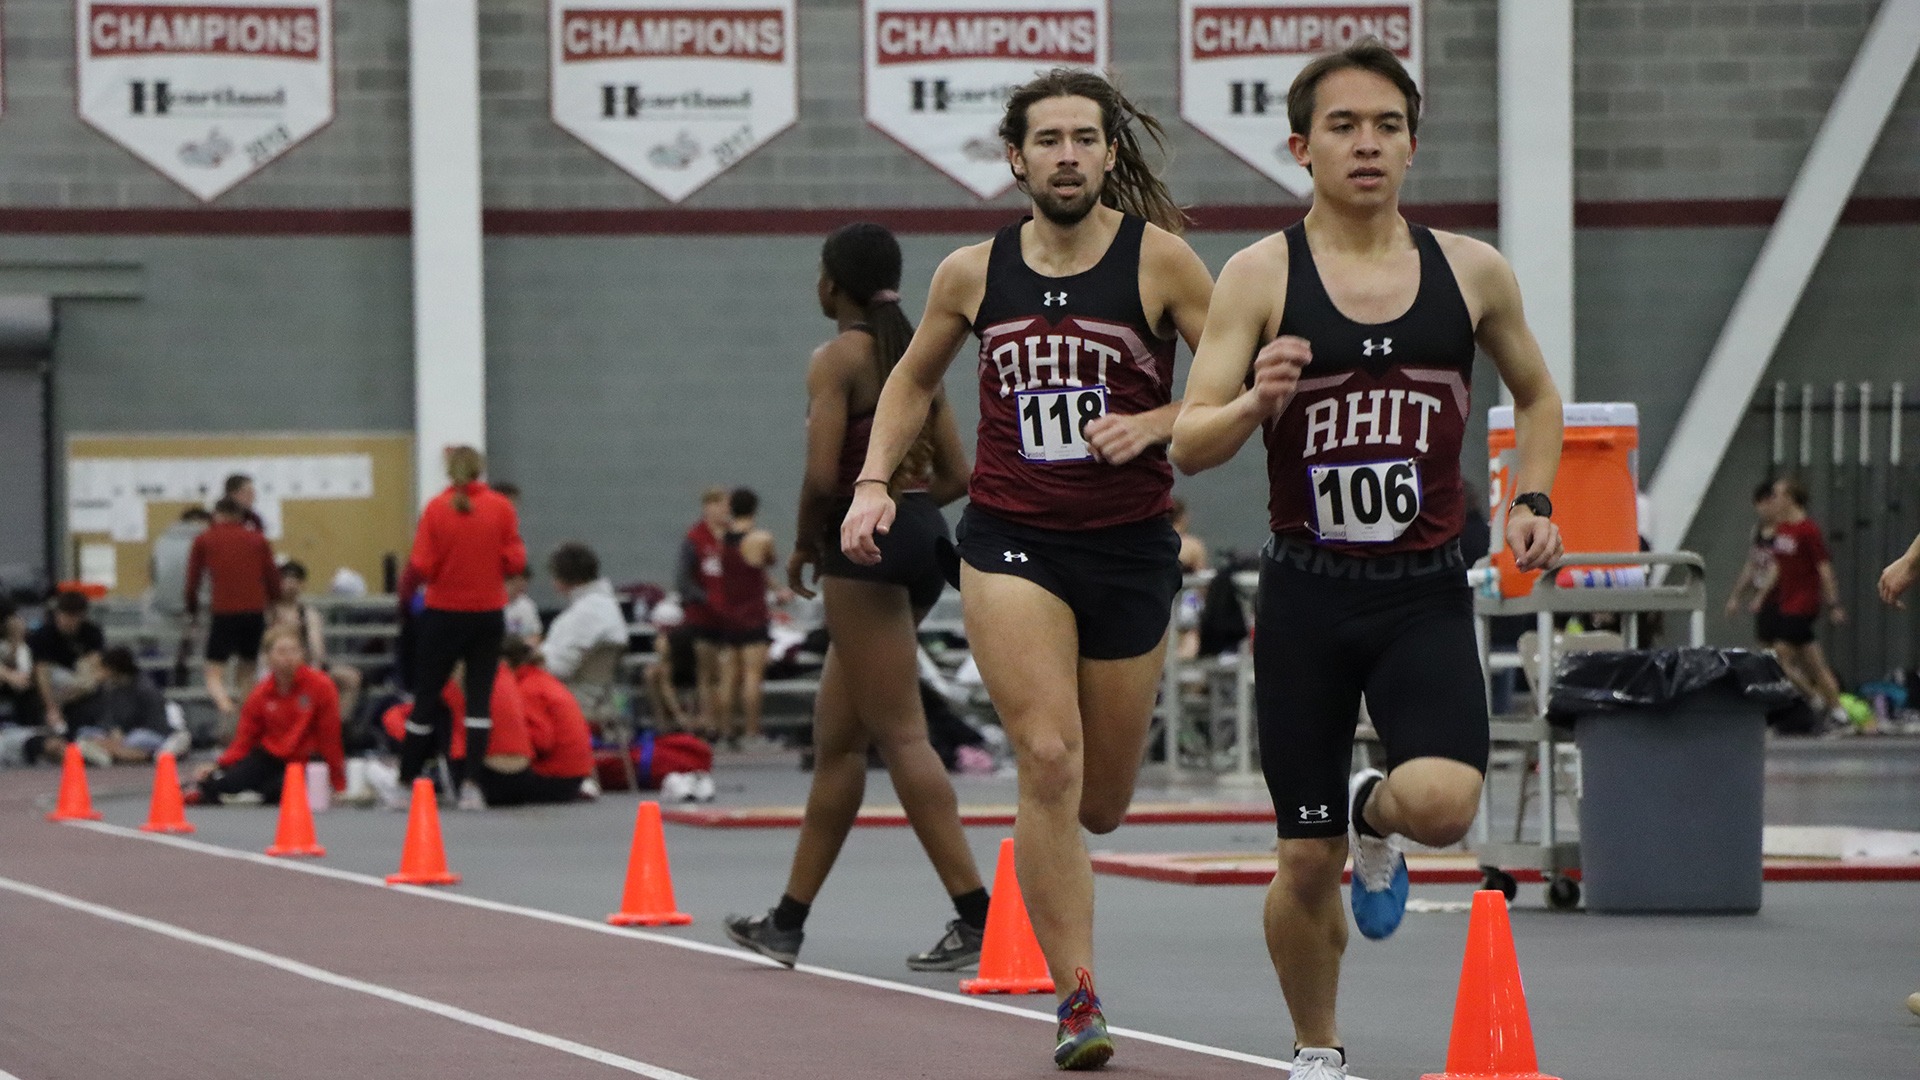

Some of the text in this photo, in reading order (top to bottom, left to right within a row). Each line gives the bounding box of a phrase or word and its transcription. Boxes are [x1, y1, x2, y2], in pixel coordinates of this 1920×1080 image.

[91, 13, 316, 54] CHAMPIONS
[564, 17, 783, 55] CHAMPIONS
[880, 16, 1093, 54] CHAMPIONS
[1196, 14, 1408, 51] CHAMPIONS
[992, 335, 1121, 398] RHIT
[1023, 391, 1102, 447] 118
[1303, 389, 1441, 459] RHIT
[1318, 463, 1418, 525] 106
